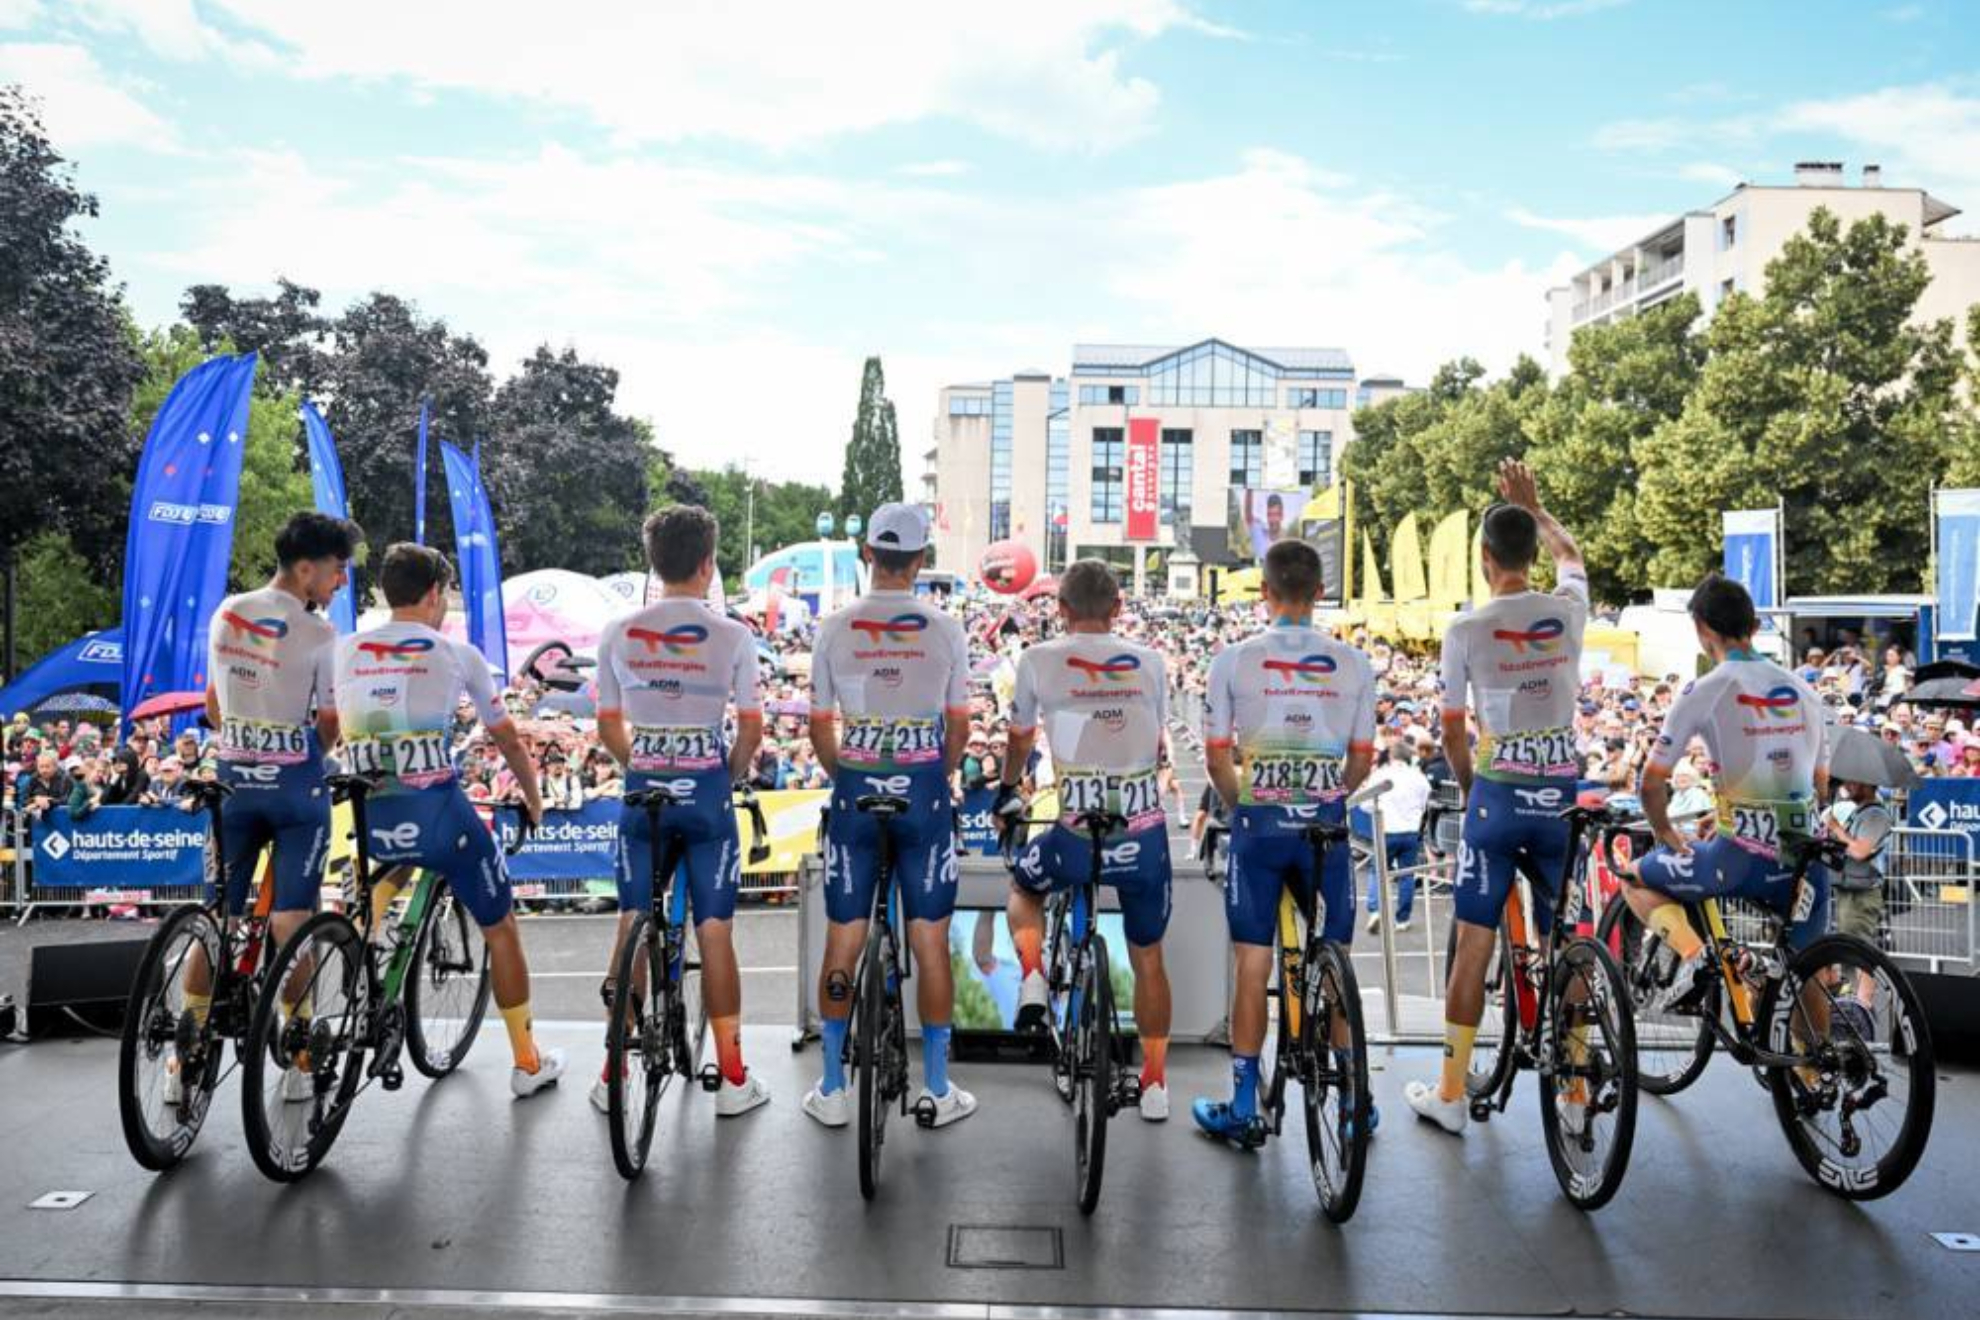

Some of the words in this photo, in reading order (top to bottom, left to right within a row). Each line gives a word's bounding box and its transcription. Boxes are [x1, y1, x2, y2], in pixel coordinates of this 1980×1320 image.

[261, 727, 305, 752] 216
[1253, 762, 1291, 788] 218
[1060, 776, 1106, 812] 213
[1734, 808, 1776, 846] 212
